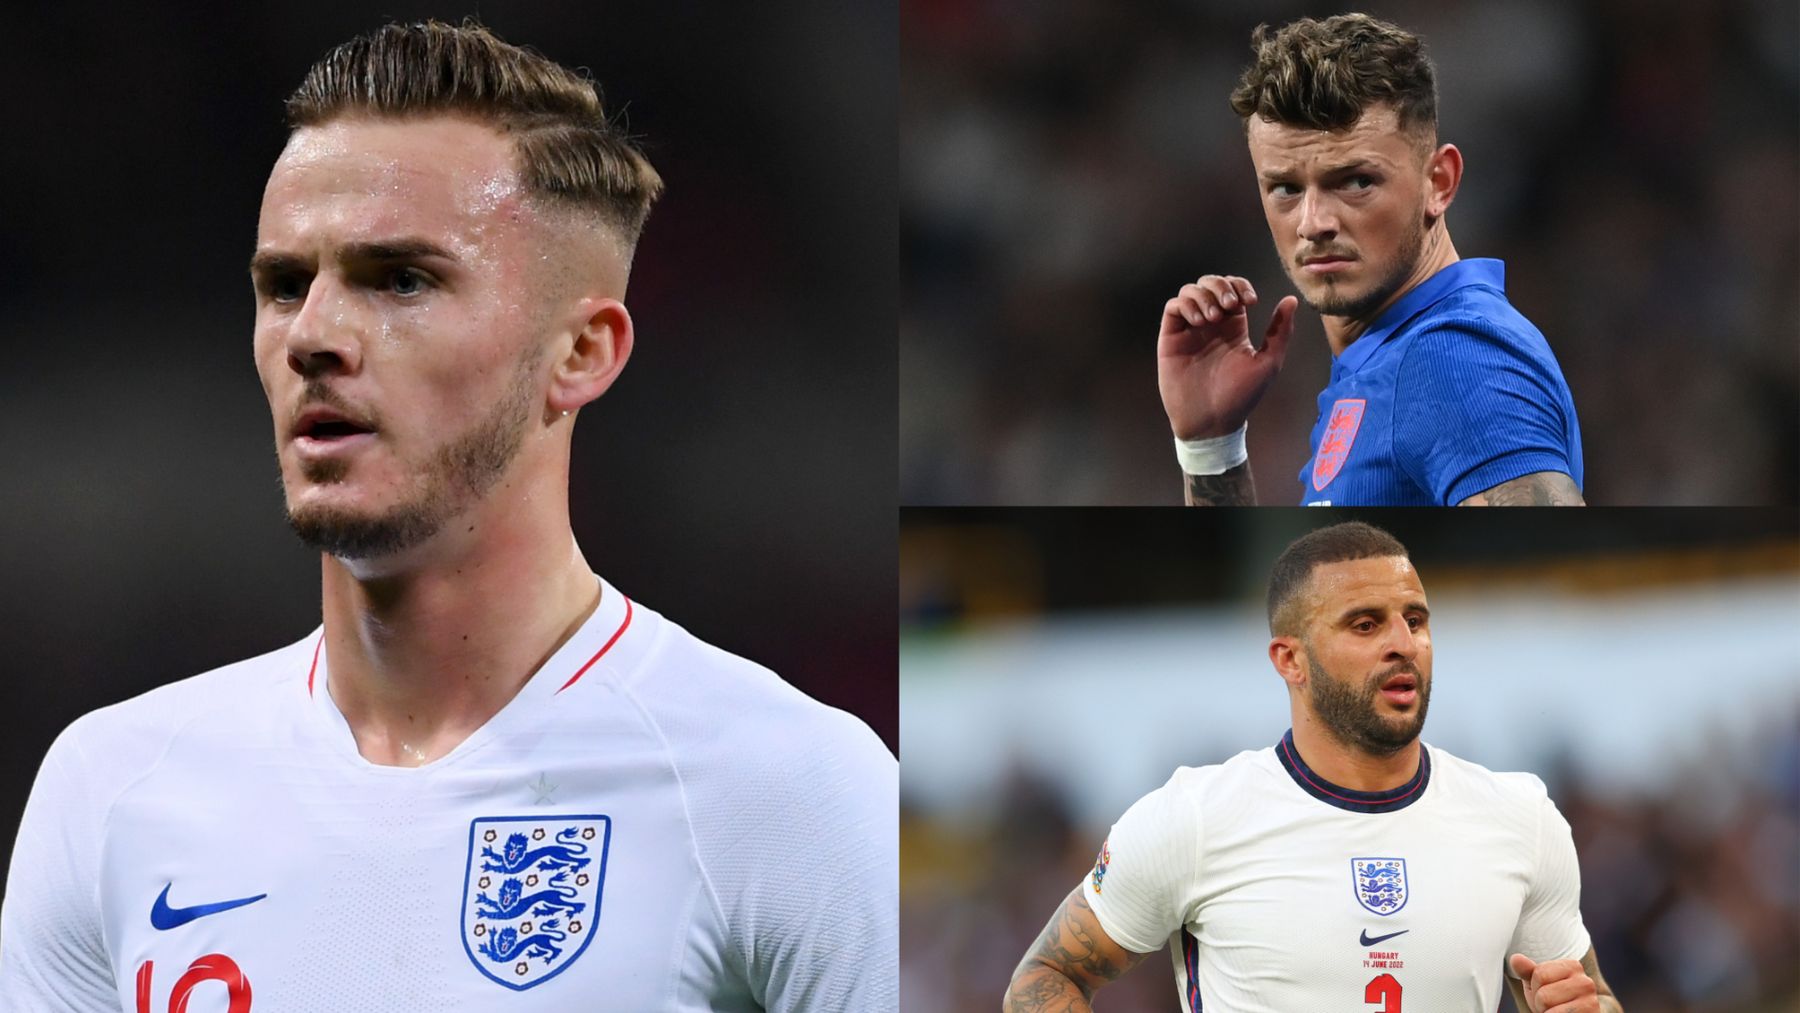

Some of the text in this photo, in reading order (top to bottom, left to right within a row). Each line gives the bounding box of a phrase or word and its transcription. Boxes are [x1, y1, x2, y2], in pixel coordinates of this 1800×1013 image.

[1369, 952, 1399, 960] HUNGARY
[1363, 960, 1370, 968] 14
[1389, 961, 1404, 969] 2022
